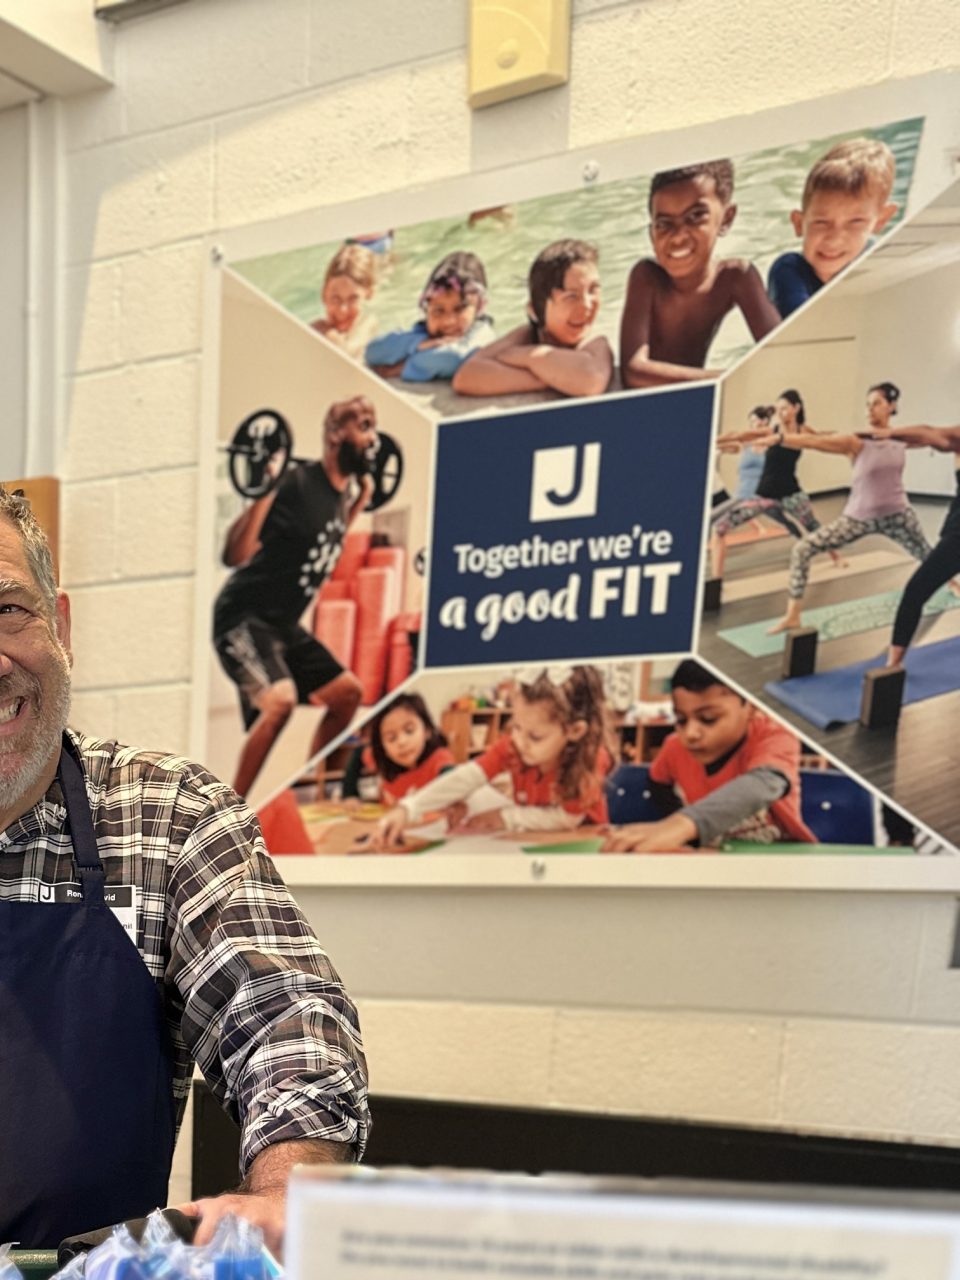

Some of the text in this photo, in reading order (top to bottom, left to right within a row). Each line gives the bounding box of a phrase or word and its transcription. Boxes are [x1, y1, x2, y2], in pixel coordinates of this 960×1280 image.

[454, 525, 673, 578] Together we're
[440, 561, 682, 642] a good FIT
